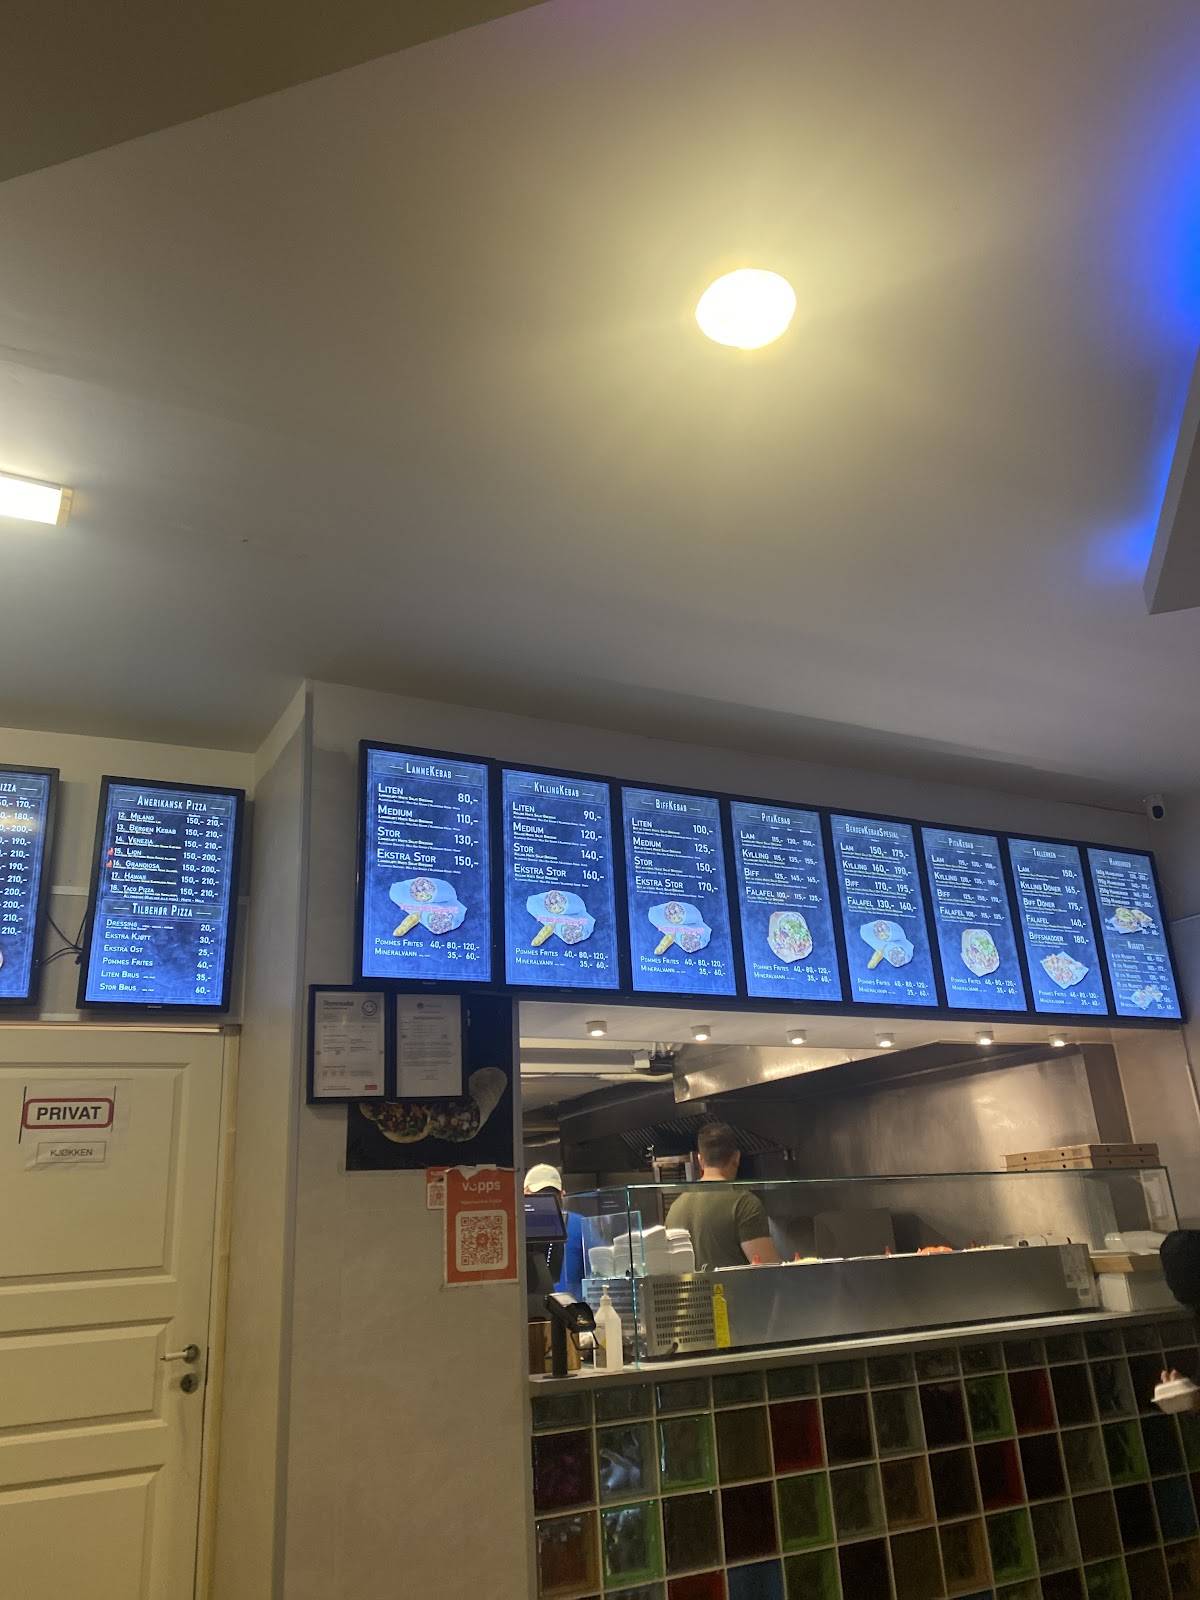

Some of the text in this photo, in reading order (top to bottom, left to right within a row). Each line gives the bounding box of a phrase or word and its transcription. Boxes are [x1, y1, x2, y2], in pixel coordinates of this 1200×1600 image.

[379, 783, 403, 795] LITEN
[458, 793, 478, 804] 80,-
[16, 800, 35, 809] 170,-
[186, 800, 207, 812] PIZZA
[378, 805, 413, 817] MEDIUM
[457, 814, 479, 826] 110,-
[513, 801, 535, 812] LITEN
[583, 811, 601, 822] 90,-
[186, 817, 204, 825] 150,-
[206, 819, 223, 827] 210,-
[631, 818, 653, 828] LITEN
[693, 825, 713, 835] 100,-
[11, 825, 32, 833] 200,-
[156, 827, 176, 835] KEBAB
[185, 829, 203, 837] 150,-
[206, 831, 223, 839] 210,-
[513, 822, 544, 833] MEDIUM
[581, 830, 602, 841] 120,-
[378, 827, 400, 837] STOR
[454, 835, 479, 846] 130,-
[12, 838, 31, 846] 190,-
[184, 840, 202, 849] 150,-
[204, 842, 222, 850] 210,-
[633, 837, 661, 848] MEDIUM
[694, 844, 715, 854] 125,-
[10, 850, 30, 858] 210,-
[183, 852, 201, 860] 150,-
[201, 854, 221, 862] 200,-
[514, 843, 534, 853] STOR
[581, 849, 604, 861] 140,-
[377, 849, 410, 860] EKSTRA
[414, 852, 436, 863] STOR
[455, 856, 479, 868] 150,-
[9, 862, 29, 871] 190,-
[182, 864, 200, 873] 150,-
[201, 866, 221, 874] 200,-
[634, 856, 653, 866] STOR
[696, 863, 716, 874] 150,-
[514, 863, 543, 875] EKSTRA
[546, 866, 566, 877] STOR
[583, 870, 604, 881] 160,-
[7, 875, 27, 883] 210,-
[181, 876, 199, 884] 150,-
[201, 877, 220, 886] 210,-
[635, 876, 663, 887] EKSTRA
[665, 879, 683, 889] STOR
[698, 882, 718, 893] 170,-
[4, 888, 26, 896] 200,-
[138, 886, 155, 894] PIZZA
[180, 888, 198, 896] 150,-
[201, 889, 219, 898] 210,-
[2, 901, 24, 909] 200,-
[171, 905, 193, 917] PIZZA
[3, 914, 23, 922] 210,-
[1, 927, 21, 935] 210,-
[201, 924, 215, 933] 20,-
[105, 932, 129, 940] EKSTRA
[199, 937, 215, 945] 30,-
[430, 941, 445, 949] 40,-
[198, 949, 214, 957] 25,-
[197, 962, 213, 970] 40,-
[101, 970, 120, 978] LITEN
[196, 974, 211, 982] 35,-
[195, 987, 211, 995] 60,-
[37, 1106, 102, 1120] PRIVAT
